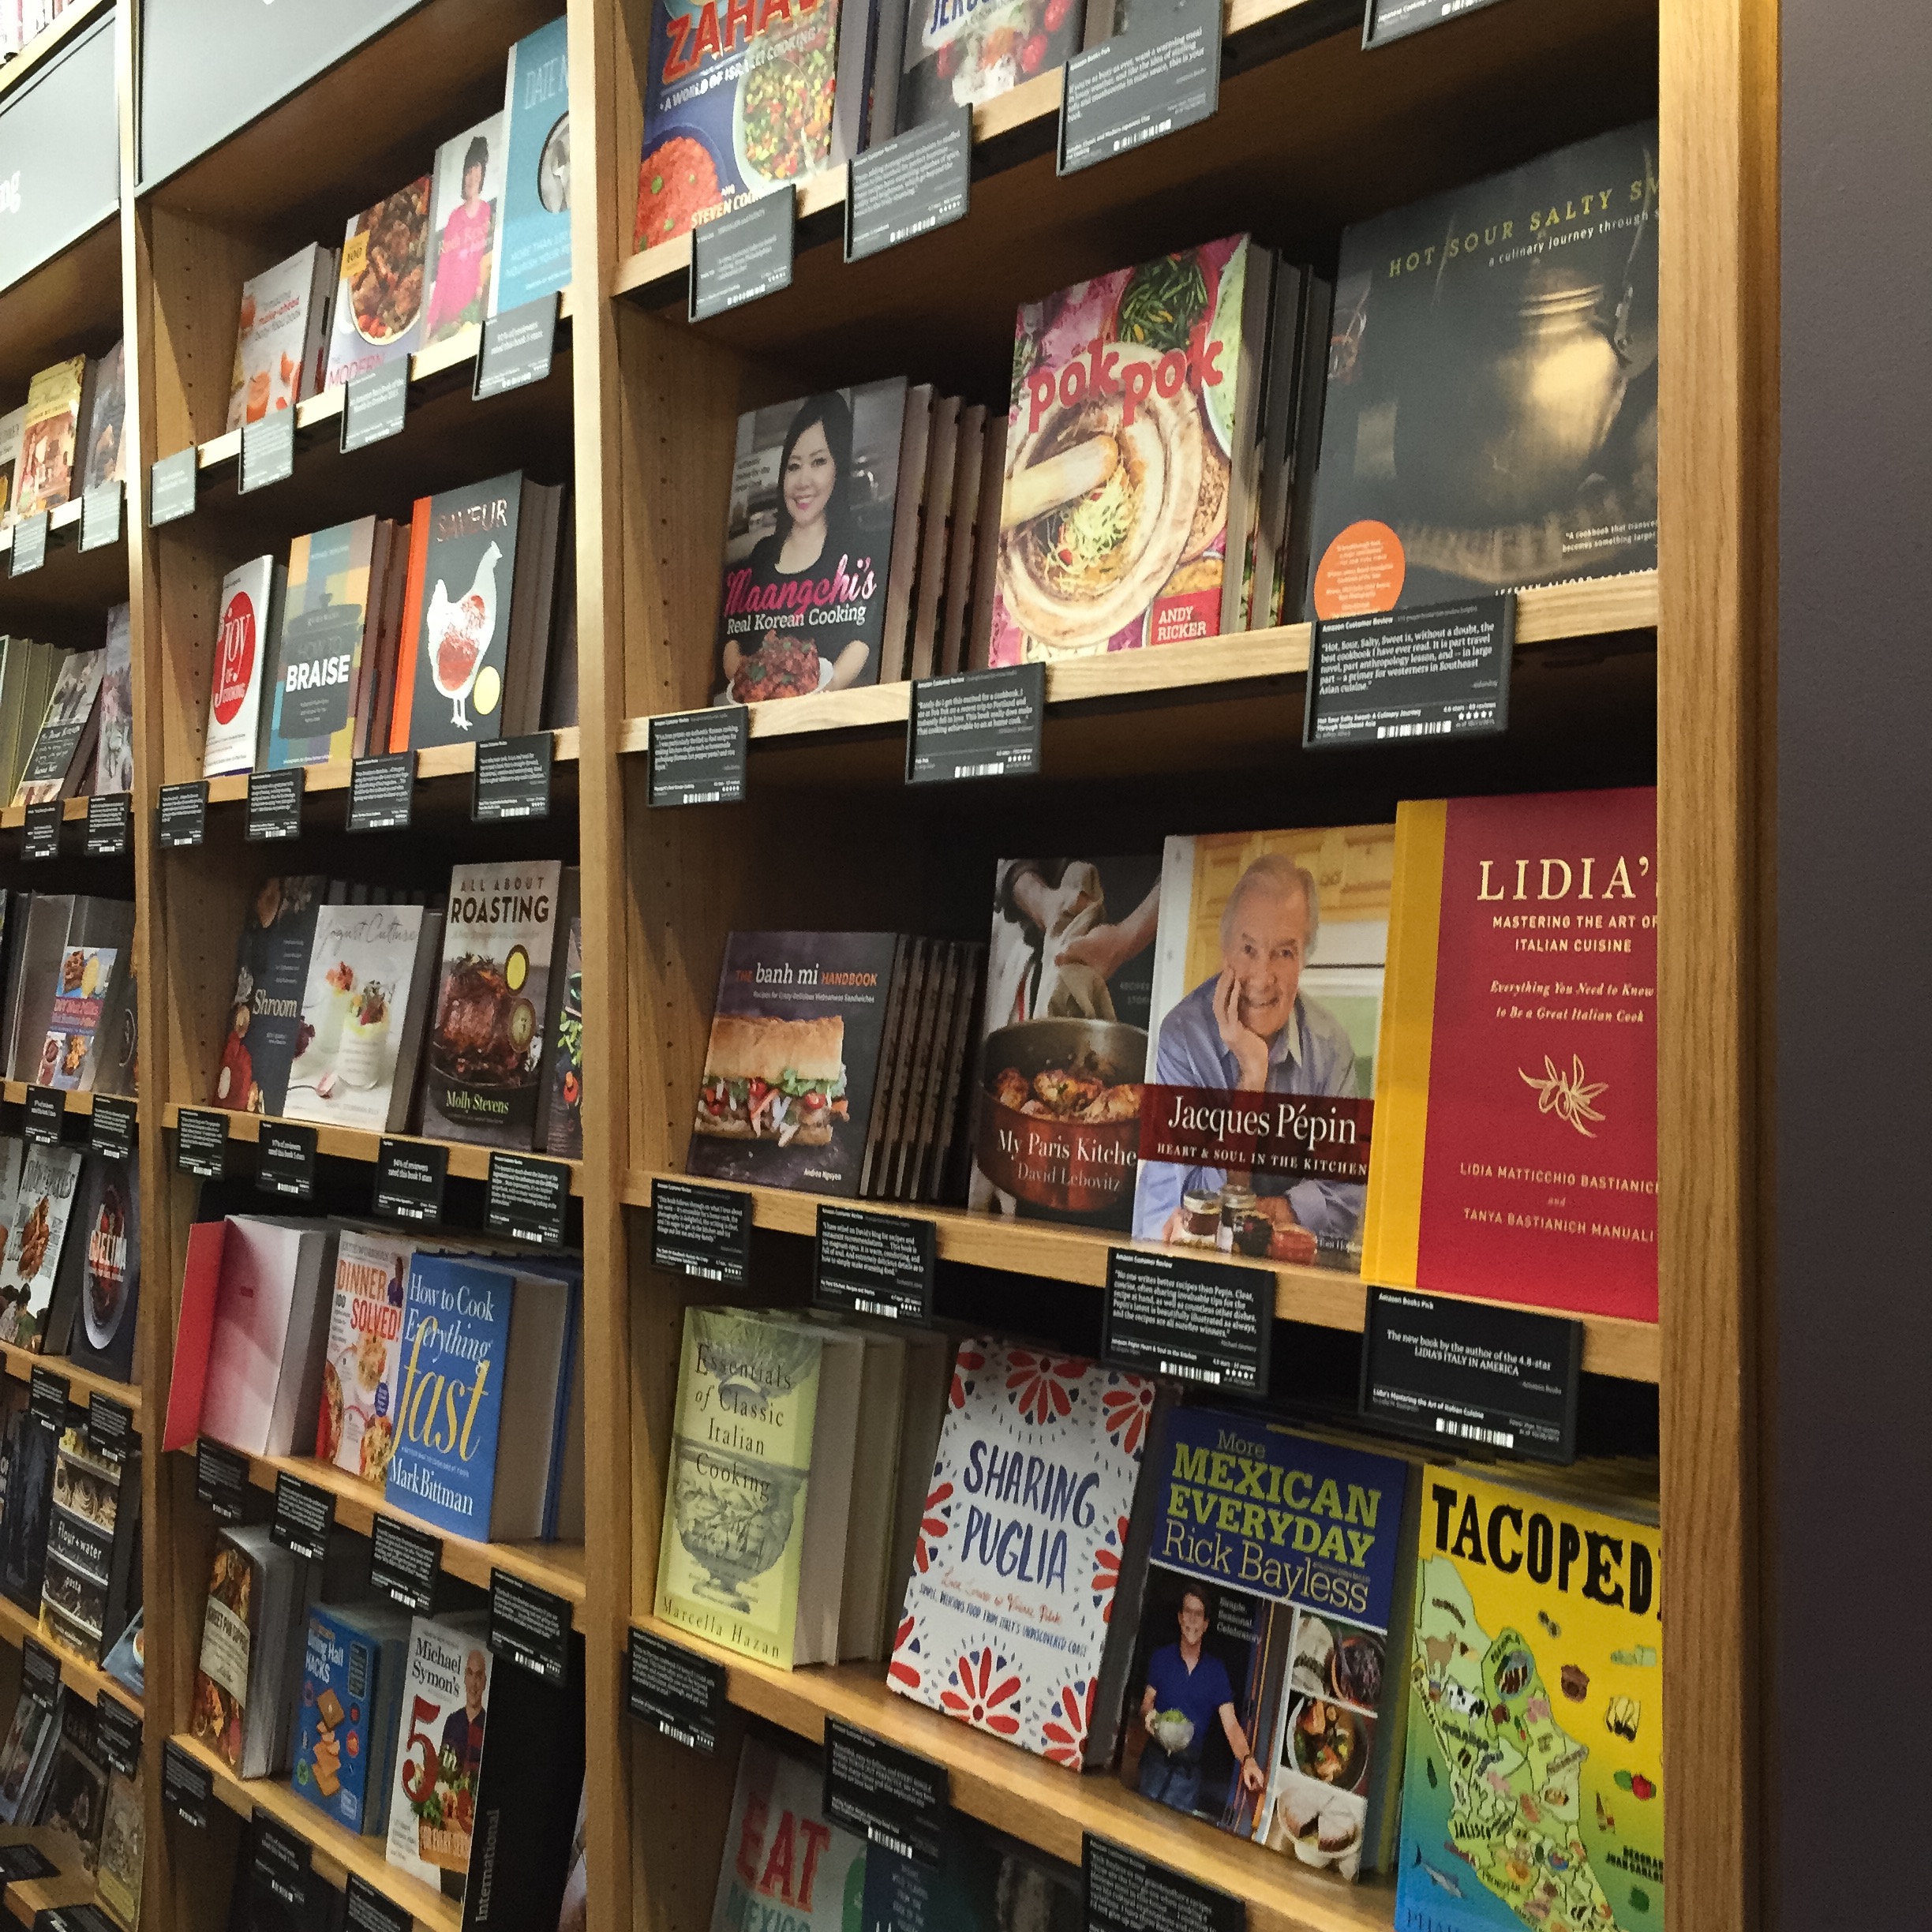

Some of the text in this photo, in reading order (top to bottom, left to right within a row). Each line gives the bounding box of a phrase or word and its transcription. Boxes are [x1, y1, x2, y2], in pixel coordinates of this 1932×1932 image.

[662, 0, 822, 85] ZAHA
[691, 195, 732, 228] STEVEN
[1389, 188, 1612, 278] HOT SOUR SALTY
[1488, 209, 1649, 268] a culinary journey through
[727, 603, 867, 635] Real Korean Cooking
[1157, 620, 1207, 641] RICKER
[1158, 605, 1194, 624] ANDY
[285, 654, 351, 693] BRAISE
[460, 876, 545, 893] ALL ABOUT
[451, 895, 549, 923] ROASTING
[1492, 915, 1636, 929] MASTERING THE ART
[1515, 938, 1632, 953] ITALIAN CUISINE
[736, 962, 878, 987] THE banh mi HANDBOOK
[1490, 979, 1654, 998] Everything You Need to Know
[253, 988, 298, 1018] Shroom
[1496, 1006, 1507, 1018] to
[1510, 1005, 1523, 1019] Be
[1536, 1006, 1568, 1021] Great
[1571, 1007, 1612, 1023] Italian
[1616, 1009, 1644, 1024] Cook
[446, 1090, 509, 1114] Molly Stevens
[1168, 1095, 1357, 1152] Jacques Pépin
[998, 1128, 1137, 1167] My Paris Kitche
[1157, 1142, 1368, 1176] HEART & SOUL IN THE KITCHEN
[1017, 1162, 1121, 1193] David Lebovitz
[1460, 1162, 1492, 1178] LIDIA
[1497, 1166, 1576, 1186] MATTICCHIO
[1547, 1196, 1566, 1208] and
[1463, 1207, 1655, 1244] TANYA BASTIANICH MANUALI
[336, 1259, 388, 1302] DINNER
[409, 1271, 495, 1323] How to Cook
[350, 1297, 402, 1342] SOLVED!
[404, 1307, 493, 1377] Everything
[1387, 1328, 1401, 1342] The
[1402, 1334, 1419, 1345] new
[1420, 1335, 1438, 1349] book
[1439, 1339, 1450, 1353] by
[1451, 1342, 1464, 1354] the
[1465, 1346, 1492, 1361] author
[1493, 1350, 1503, 1361] of
[1503, 1351, 1518, 1364] the
[695, 1342, 791, 1390] Essentials
[1443, 1349, 1467, 1368] ITALY
[1468, 1355, 1478, 1368] IN
[1479, 1358, 1520, 1376] AMERICA
[390, 1315, 490, 1462] fast
[695, 1384, 784, 1427] of Classic
[708, 1417, 765, 1456] Italian
[1218, 1428, 1266, 1458] More
[389, 1455, 419, 1495] Mark
[419, 1470, 474, 1517] Bittman
[696, 1451, 771, 1503] Cooking
[964, 1440, 1100, 1529] SHARING
[1172, 1442, 1382, 1529] MEXICAN
[58, 1520, 102, 1560] flour water
[1166, 1482, 1376, 1569] EVERYDAY
[961, 1504, 1068, 1594] PUGLIA
[1162, 1518, 1369, 1615] Rick Bayless
[1432, 1483, 1662, 1622] TACOPED
[663, 1596, 780, 1659] Marcella Hazan
[305, 1649, 331, 1684] HACKS
[328, 1641, 344, 1668] Hall
[414, 1636, 462, 1676] Michael
[401, 1693, 441, 1803] 5
[475, 1808, 500, 1923] International
[736, 1810, 833, 1914] EAT
